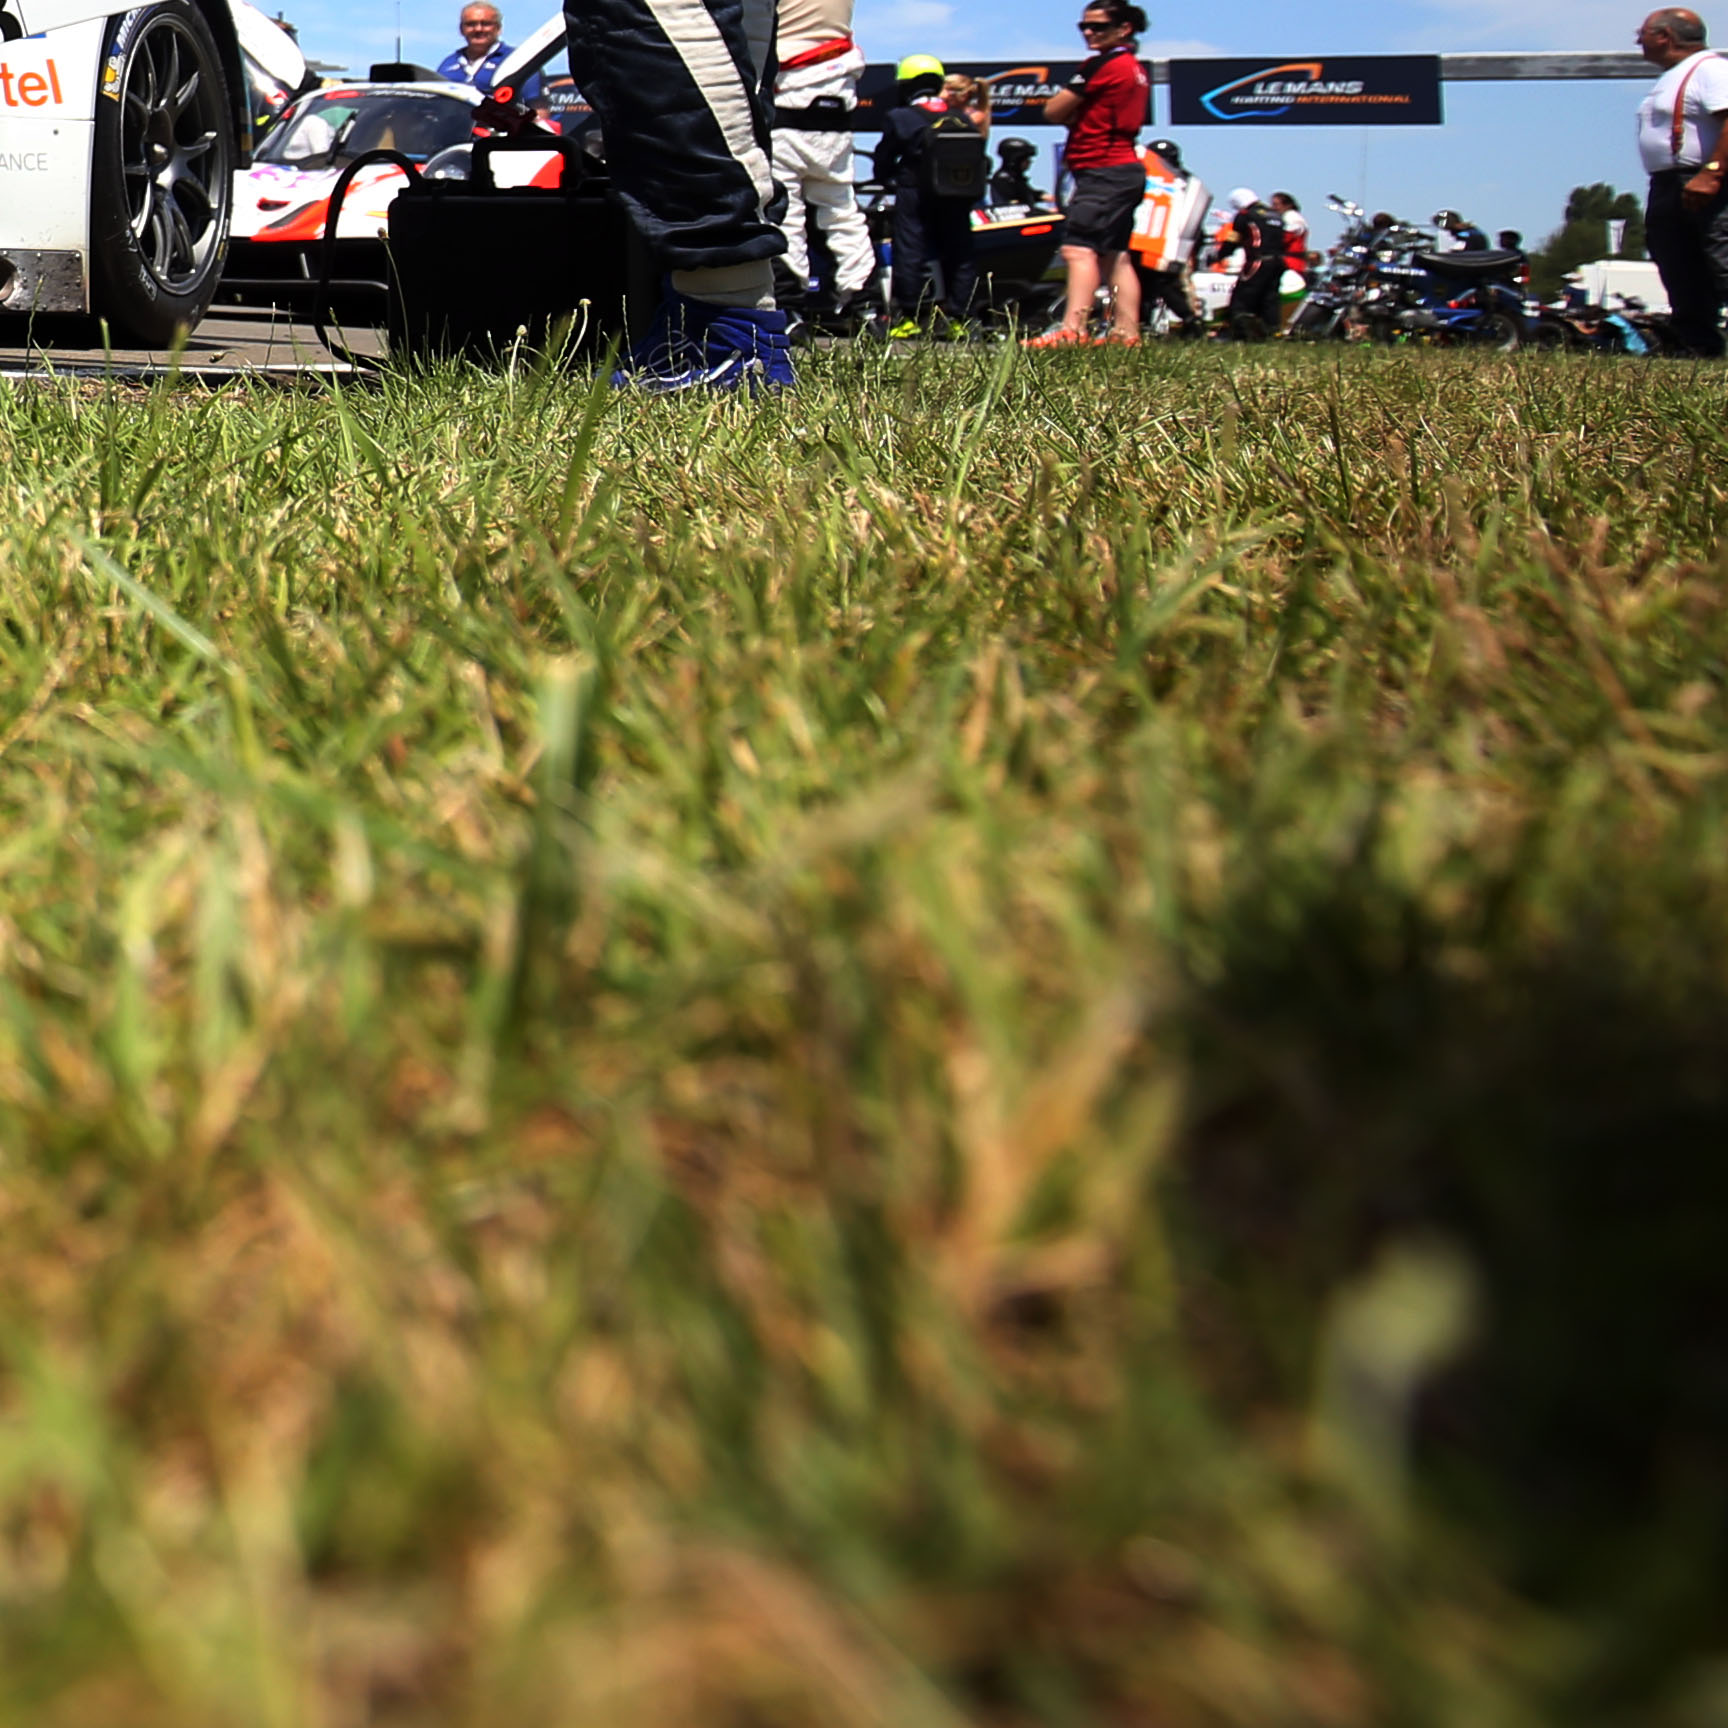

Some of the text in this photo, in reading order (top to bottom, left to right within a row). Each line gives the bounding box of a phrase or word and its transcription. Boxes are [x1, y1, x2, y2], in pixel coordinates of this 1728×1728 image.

[1015, 84, 1064, 96] MAN
[1254, 80, 1365, 95] LE MANS
